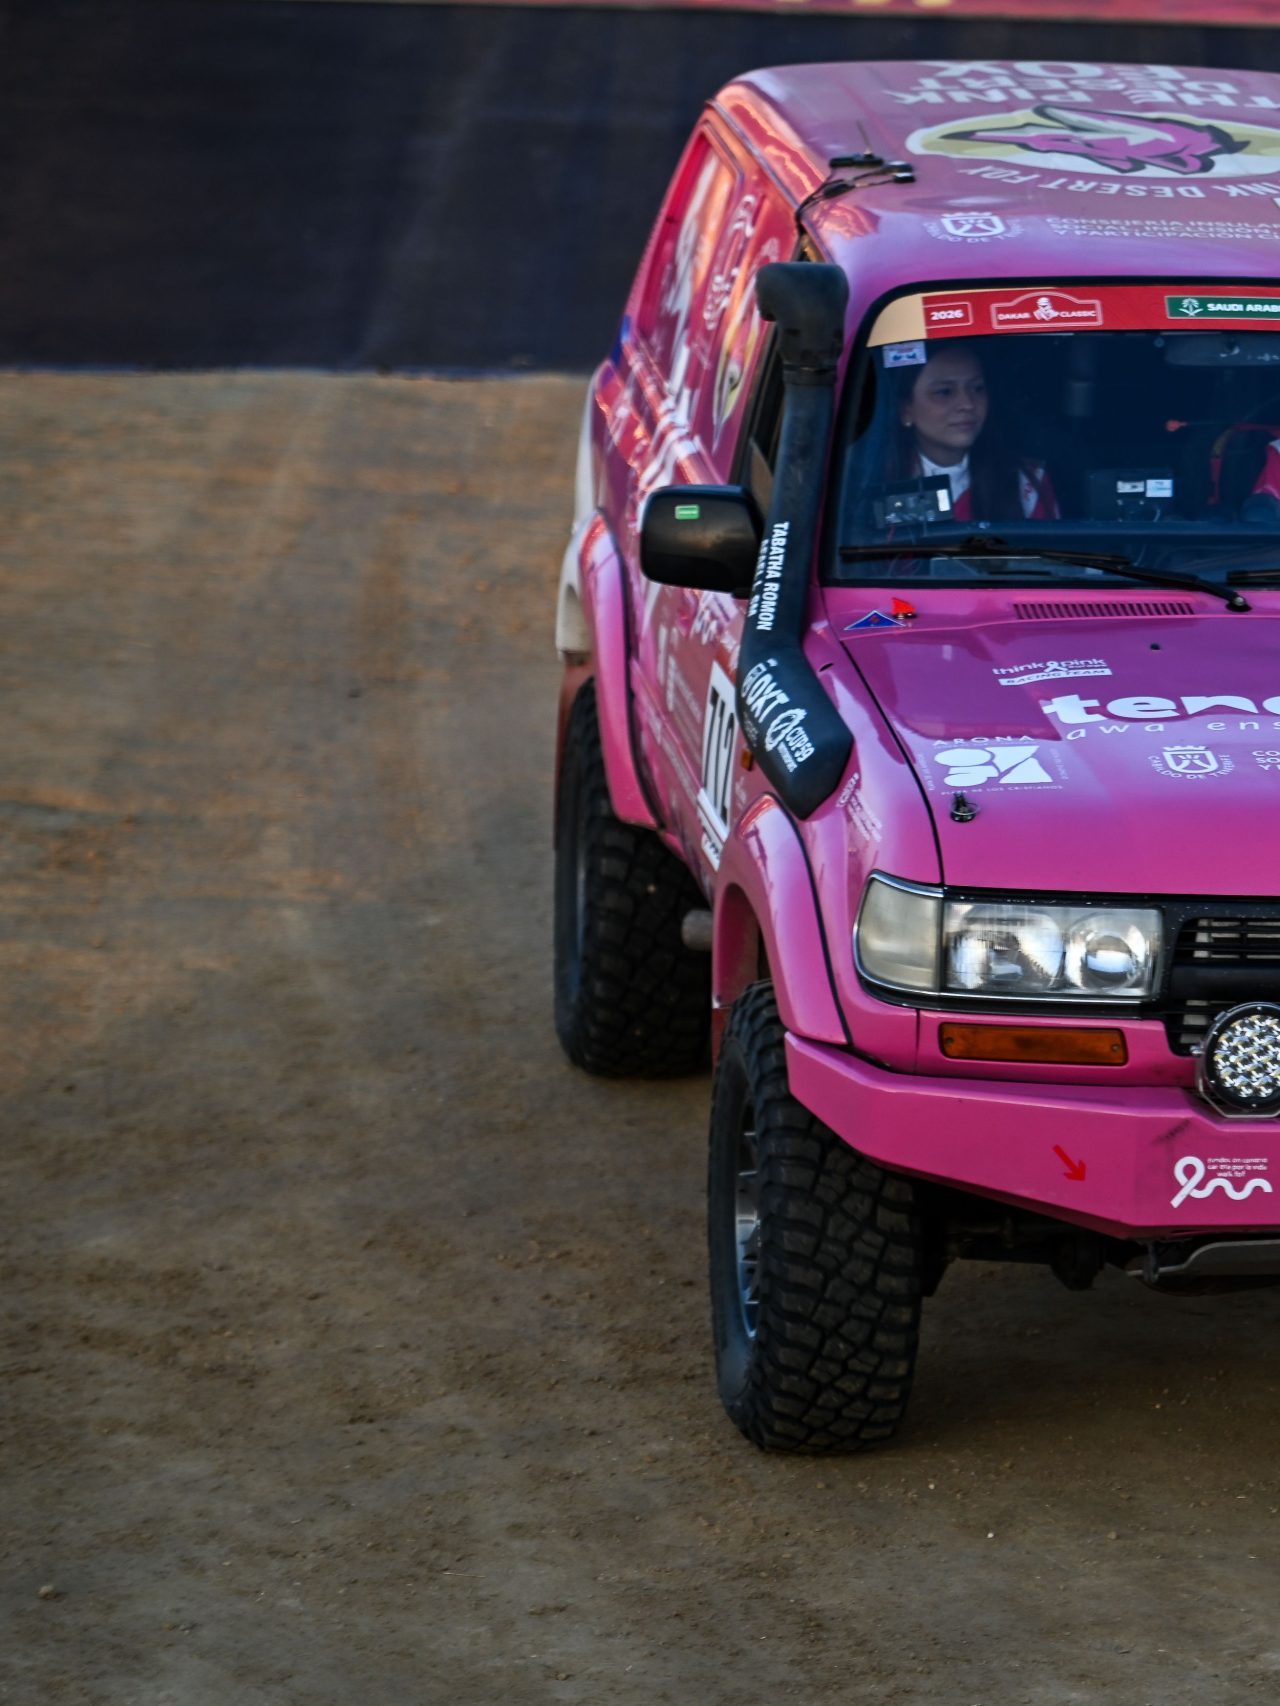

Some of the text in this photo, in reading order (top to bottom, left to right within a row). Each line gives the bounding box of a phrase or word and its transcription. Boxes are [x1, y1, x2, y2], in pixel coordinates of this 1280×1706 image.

[882, 89, 1094, 104] PINK
[1038, 177, 1206, 198] DESERT
[1206, 303, 1243, 312] SAUDI
[930, 309, 964, 321] 2026
[997, 310, 1096, 321] DAKAR CLASSIC
[765, 521, 790, 579] TABATHA
[756, 582, 780, 631] ROMON
[992, 662, 1045, 674] think
[933, 735, 1035, 746] ARONA
